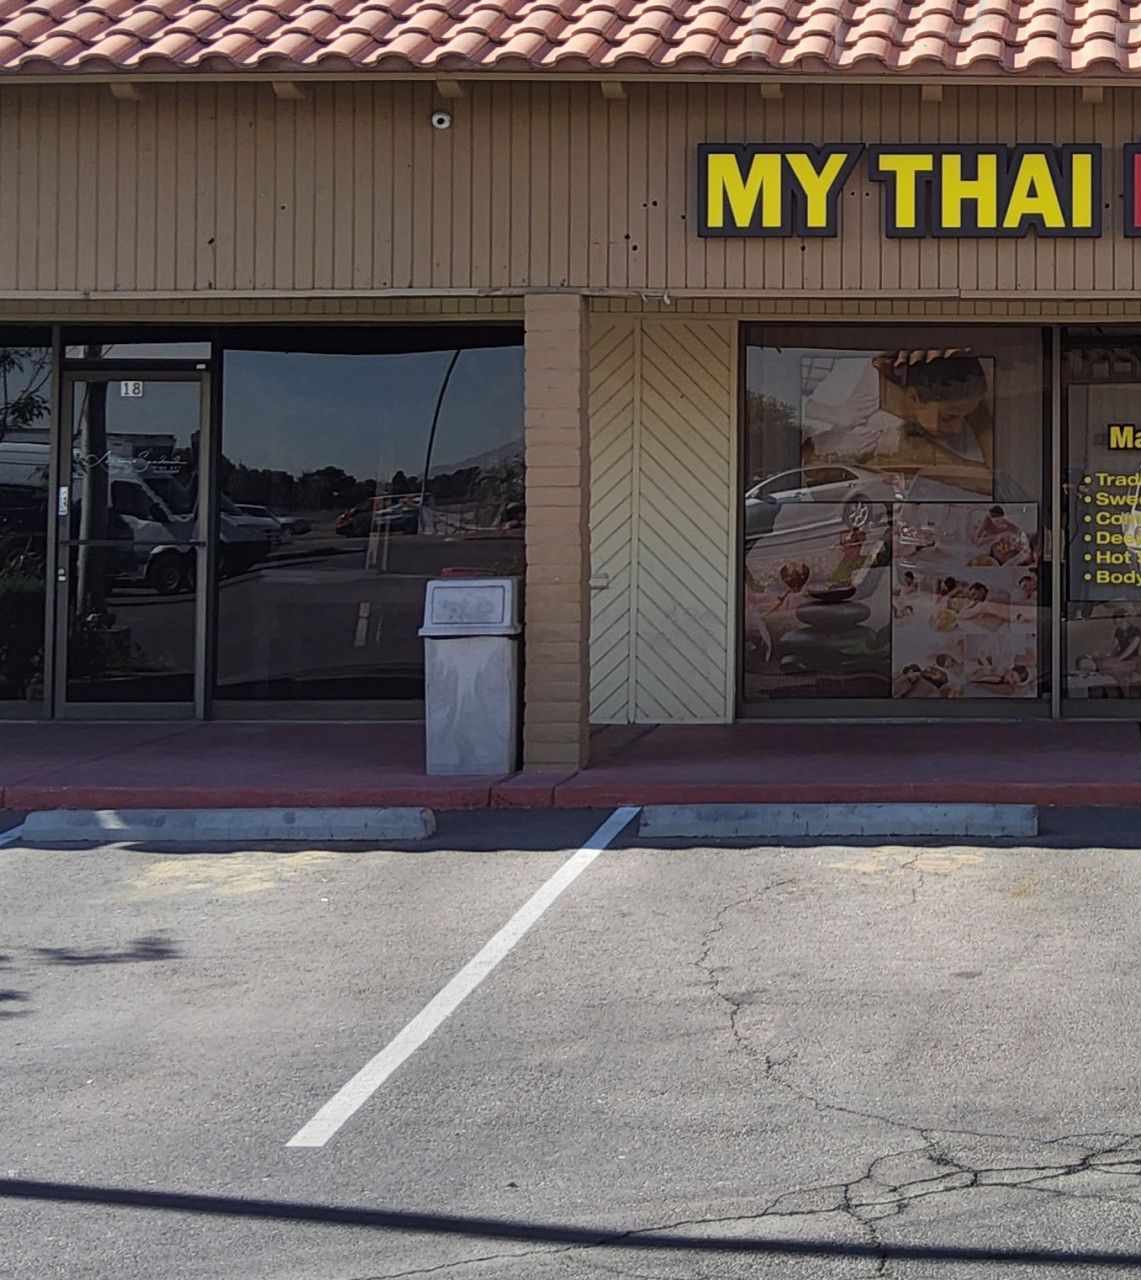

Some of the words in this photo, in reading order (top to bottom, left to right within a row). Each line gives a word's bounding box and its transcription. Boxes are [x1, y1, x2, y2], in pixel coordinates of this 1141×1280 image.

[707, 153, 847, 228] MY
[879, 153, 1092, 228] THAI
[123, 382, 141, 395] 18
[1096, 551, 1131, 564] Hot
